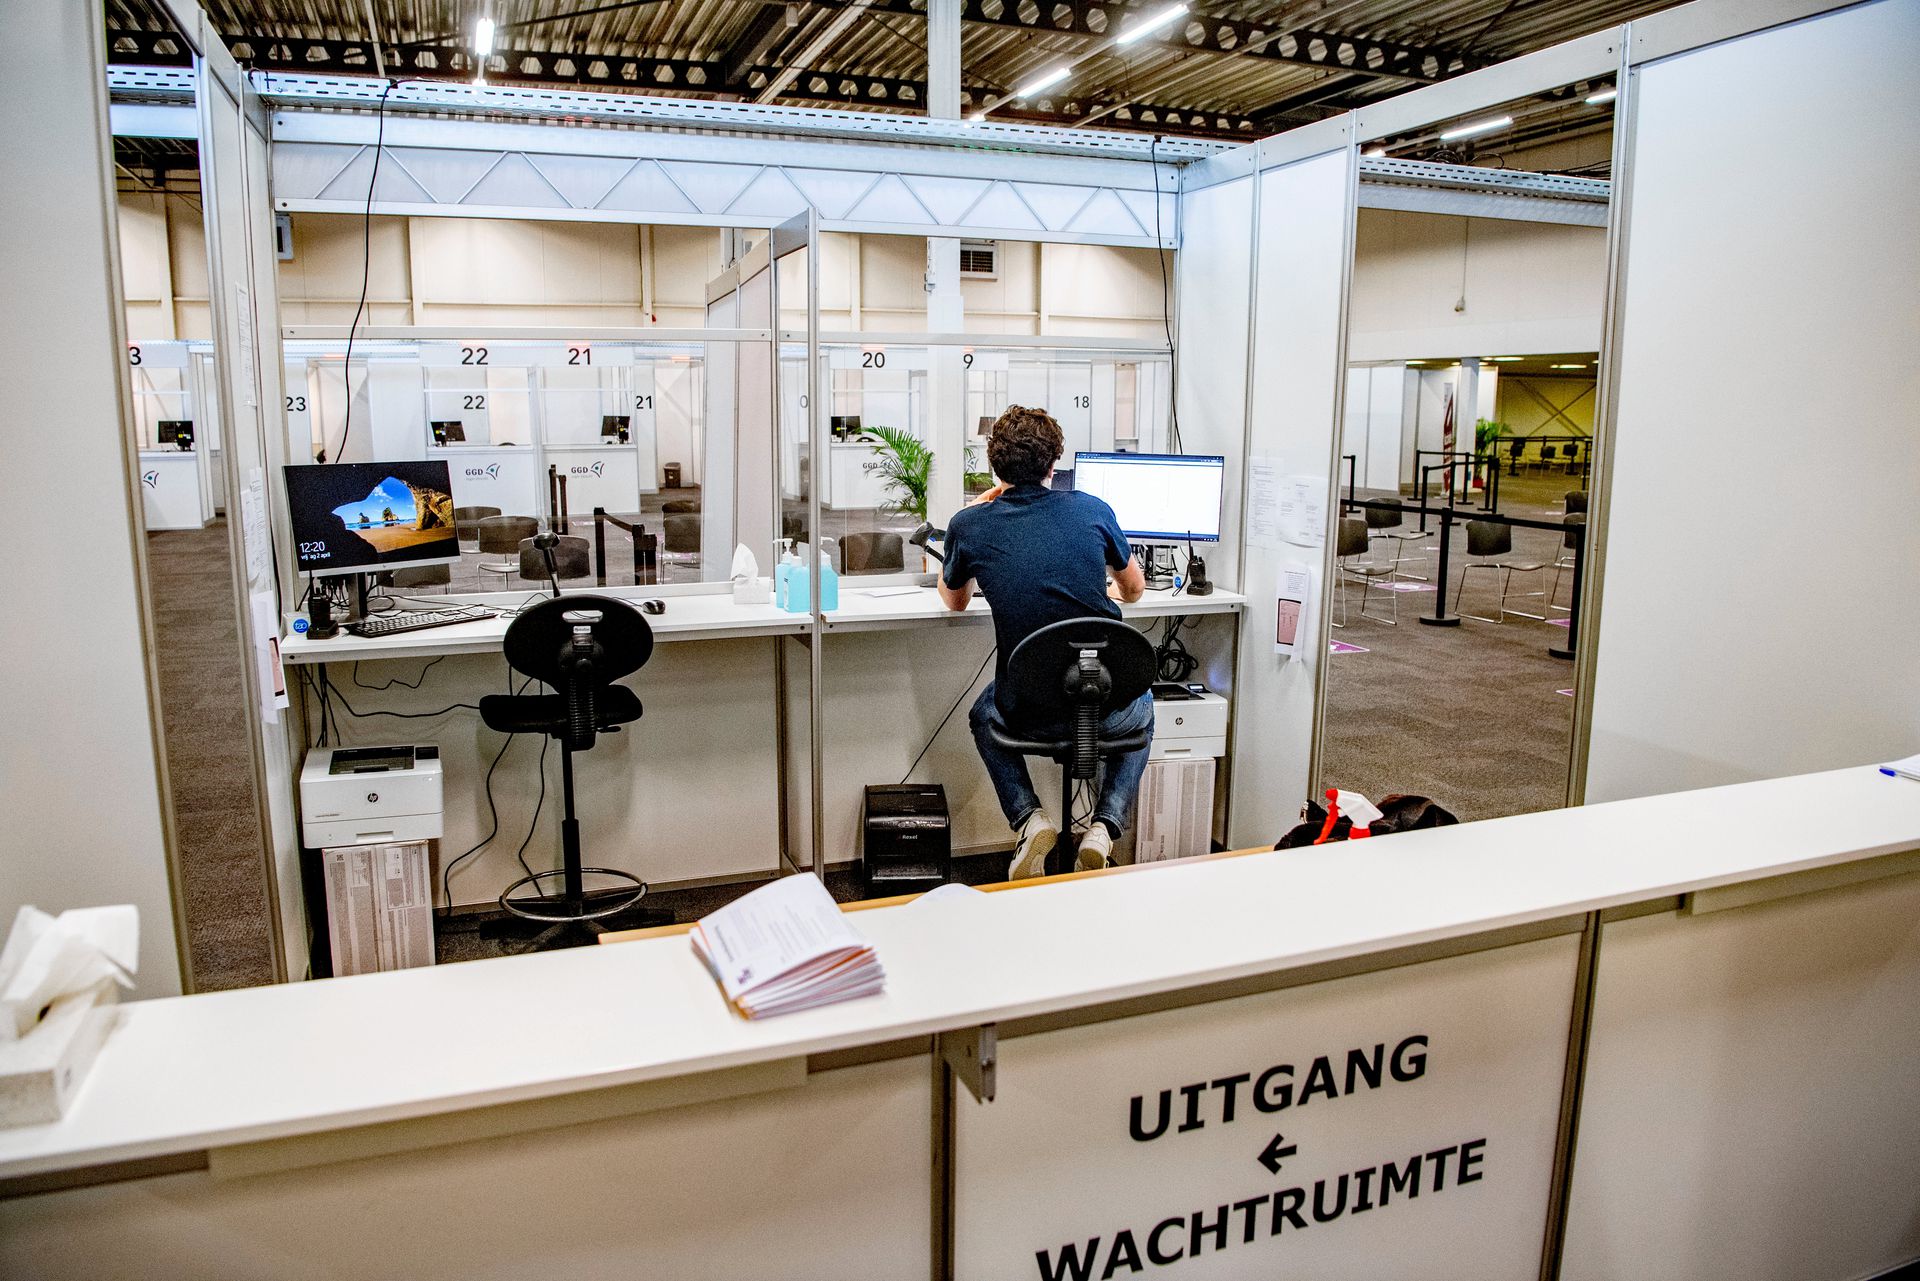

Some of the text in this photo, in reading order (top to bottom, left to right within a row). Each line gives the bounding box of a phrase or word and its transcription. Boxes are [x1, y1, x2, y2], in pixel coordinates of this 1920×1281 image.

[130, 346, 142, 366] 3
[461, 347, 489, 366] 22
[568, 347, 591, 366] 21
[862, 351, 886, 369] 20
[963, 353, 974, 370] 9
[286, 396, 306, 412] 23
[463, 395, 486, 410] 22
[635, 395, 653, 410] 21
[1073, 395, 1090, 409] 18
[465, 468, 484, 476] GGD
[570, 465, 589, 474] GGD
[299, 540, 326, 553] 12:20
[1128, 1035, 1429, 1142] UITGANG
[1034, 1138, 1487, 1281] WACHTRUIMTE
